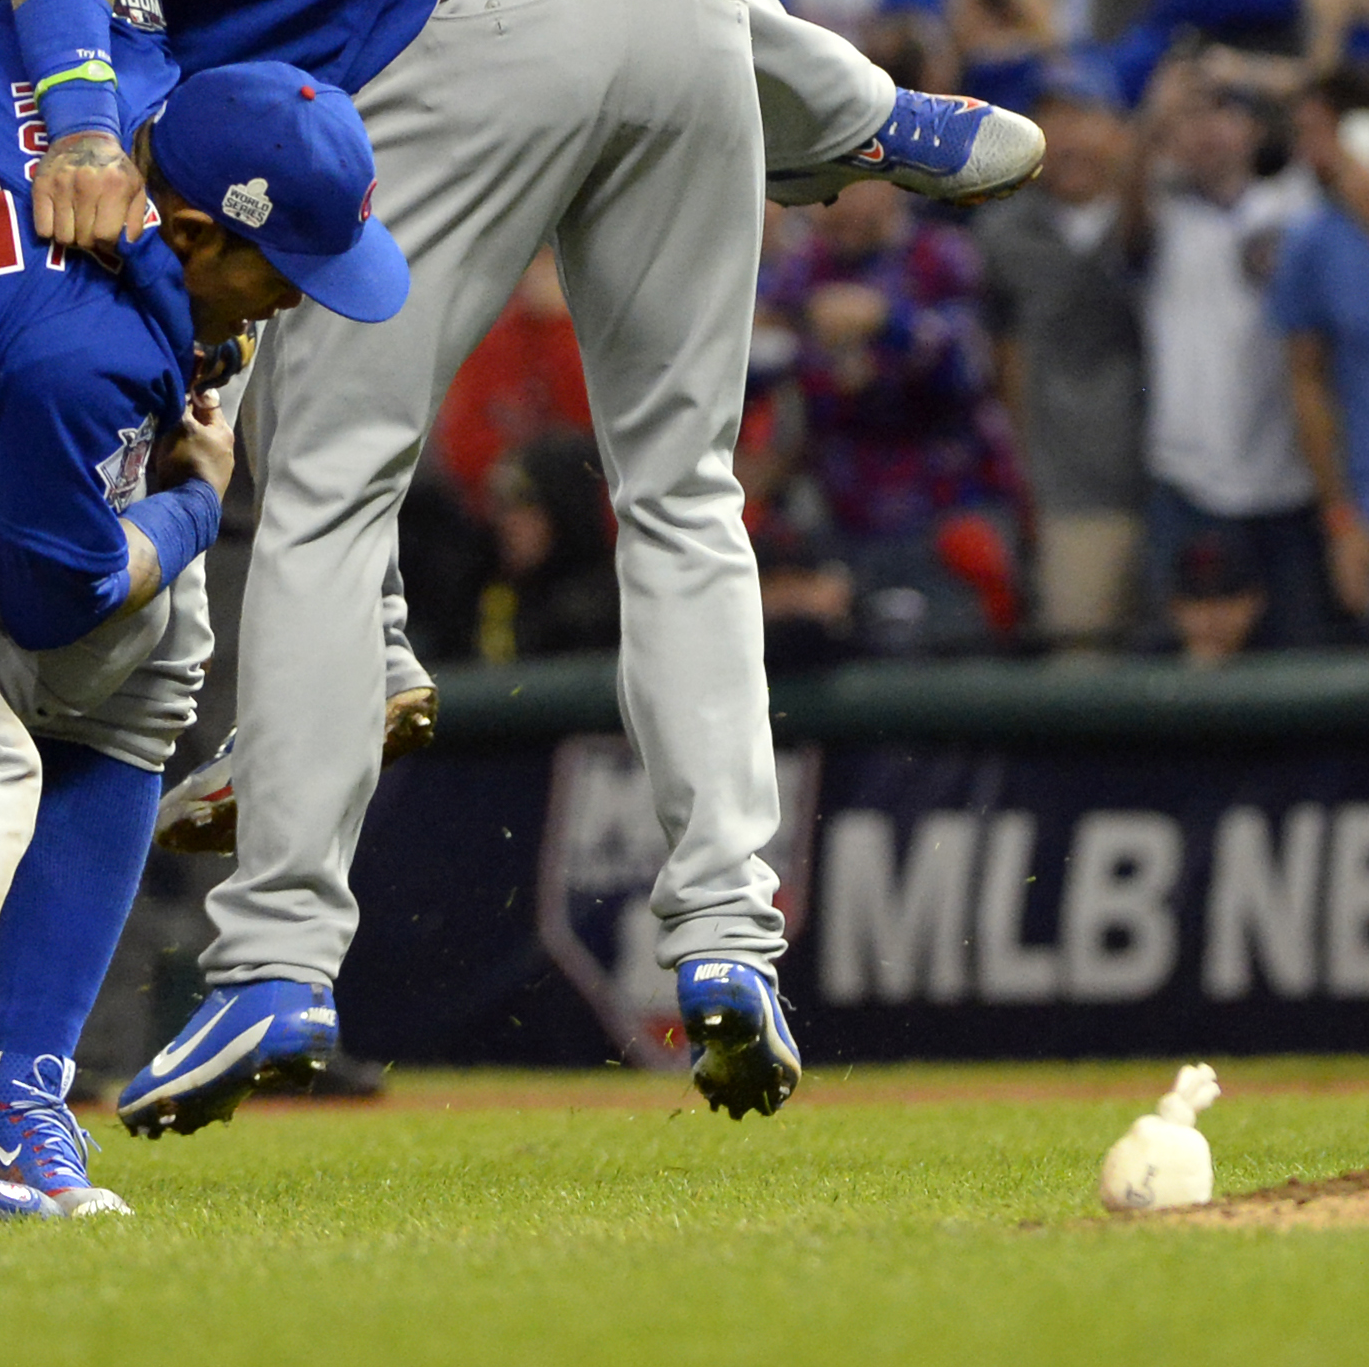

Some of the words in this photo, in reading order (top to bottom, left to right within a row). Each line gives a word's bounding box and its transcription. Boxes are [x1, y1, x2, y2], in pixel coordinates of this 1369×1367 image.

[76, 48, 96, 59] Try
[224, 197, 266, 223] SERIES
[230, 188, 270, 212] WORLD
[823, 808, 1183, 1002] MLB
[693, 962, 734, 983] NIKE
